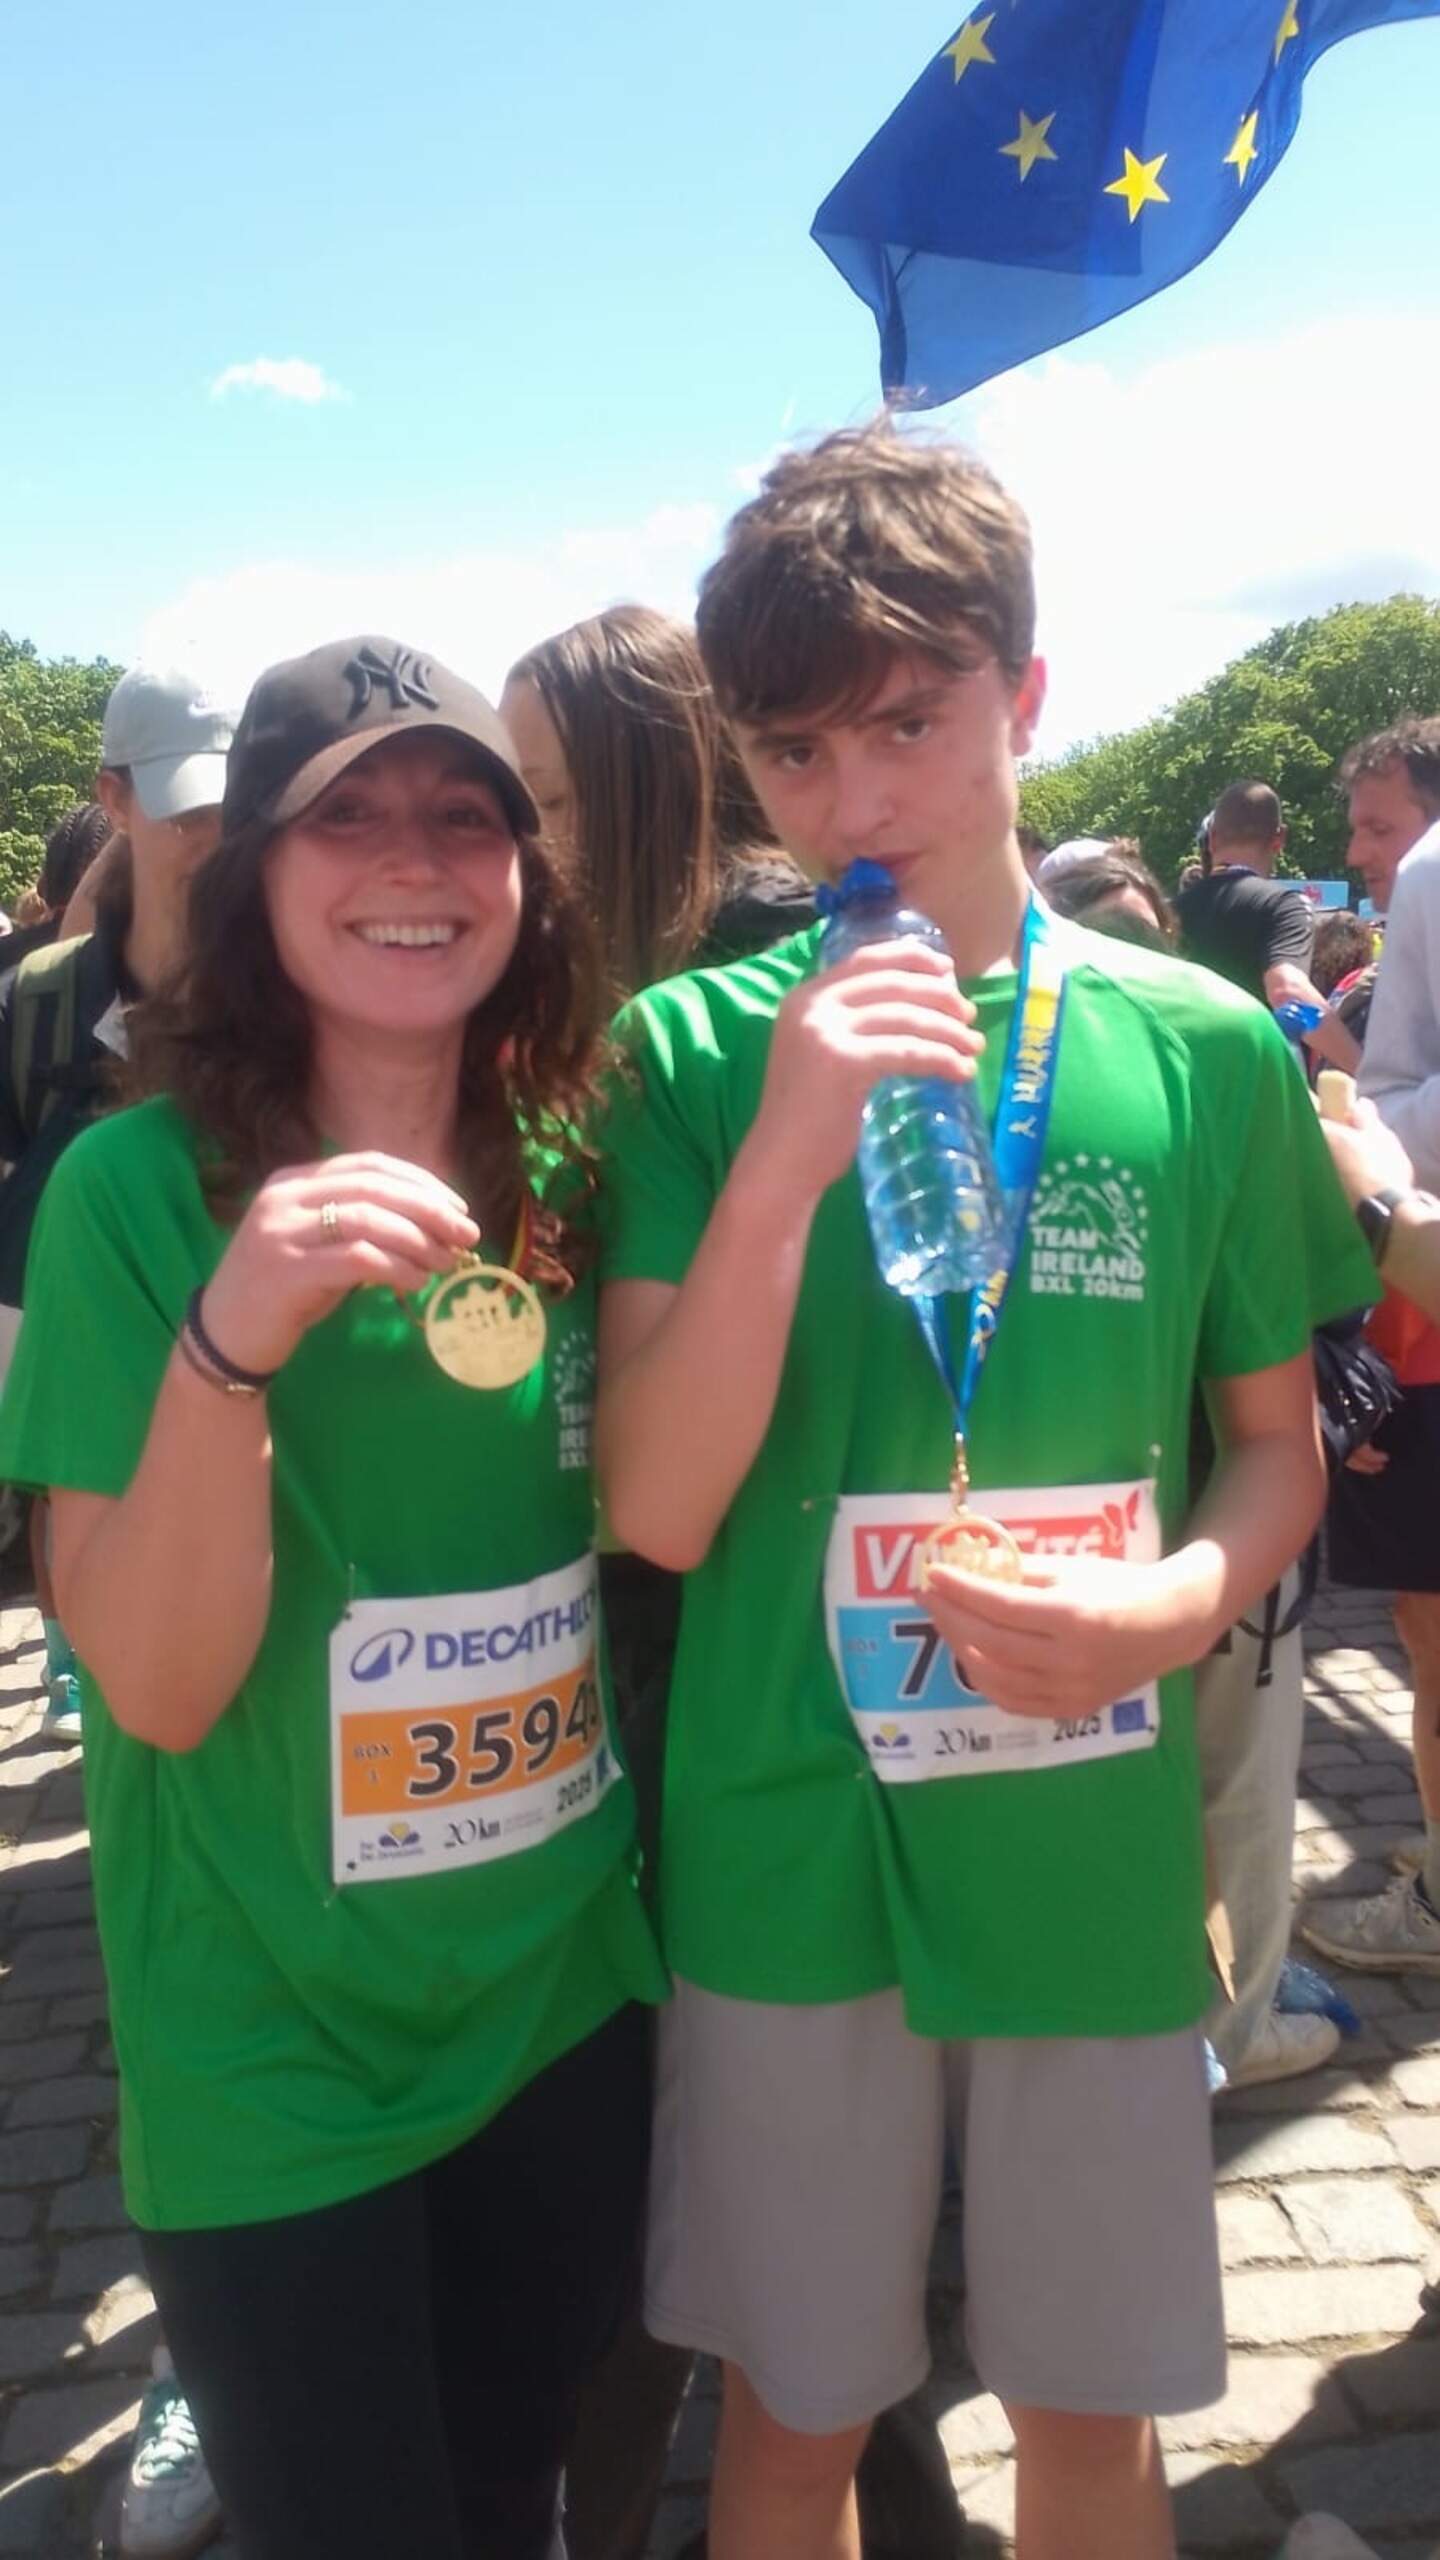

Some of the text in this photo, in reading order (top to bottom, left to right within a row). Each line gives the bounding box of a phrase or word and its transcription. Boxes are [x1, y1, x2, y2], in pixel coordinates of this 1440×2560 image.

[342, 646, 440, 720] NY
[1030, 1225, 1098, 1251] TEAM
[1030, 1250, 1145, 1281] IRELAND
[1030, 1273, 1076, 1296] BXL
